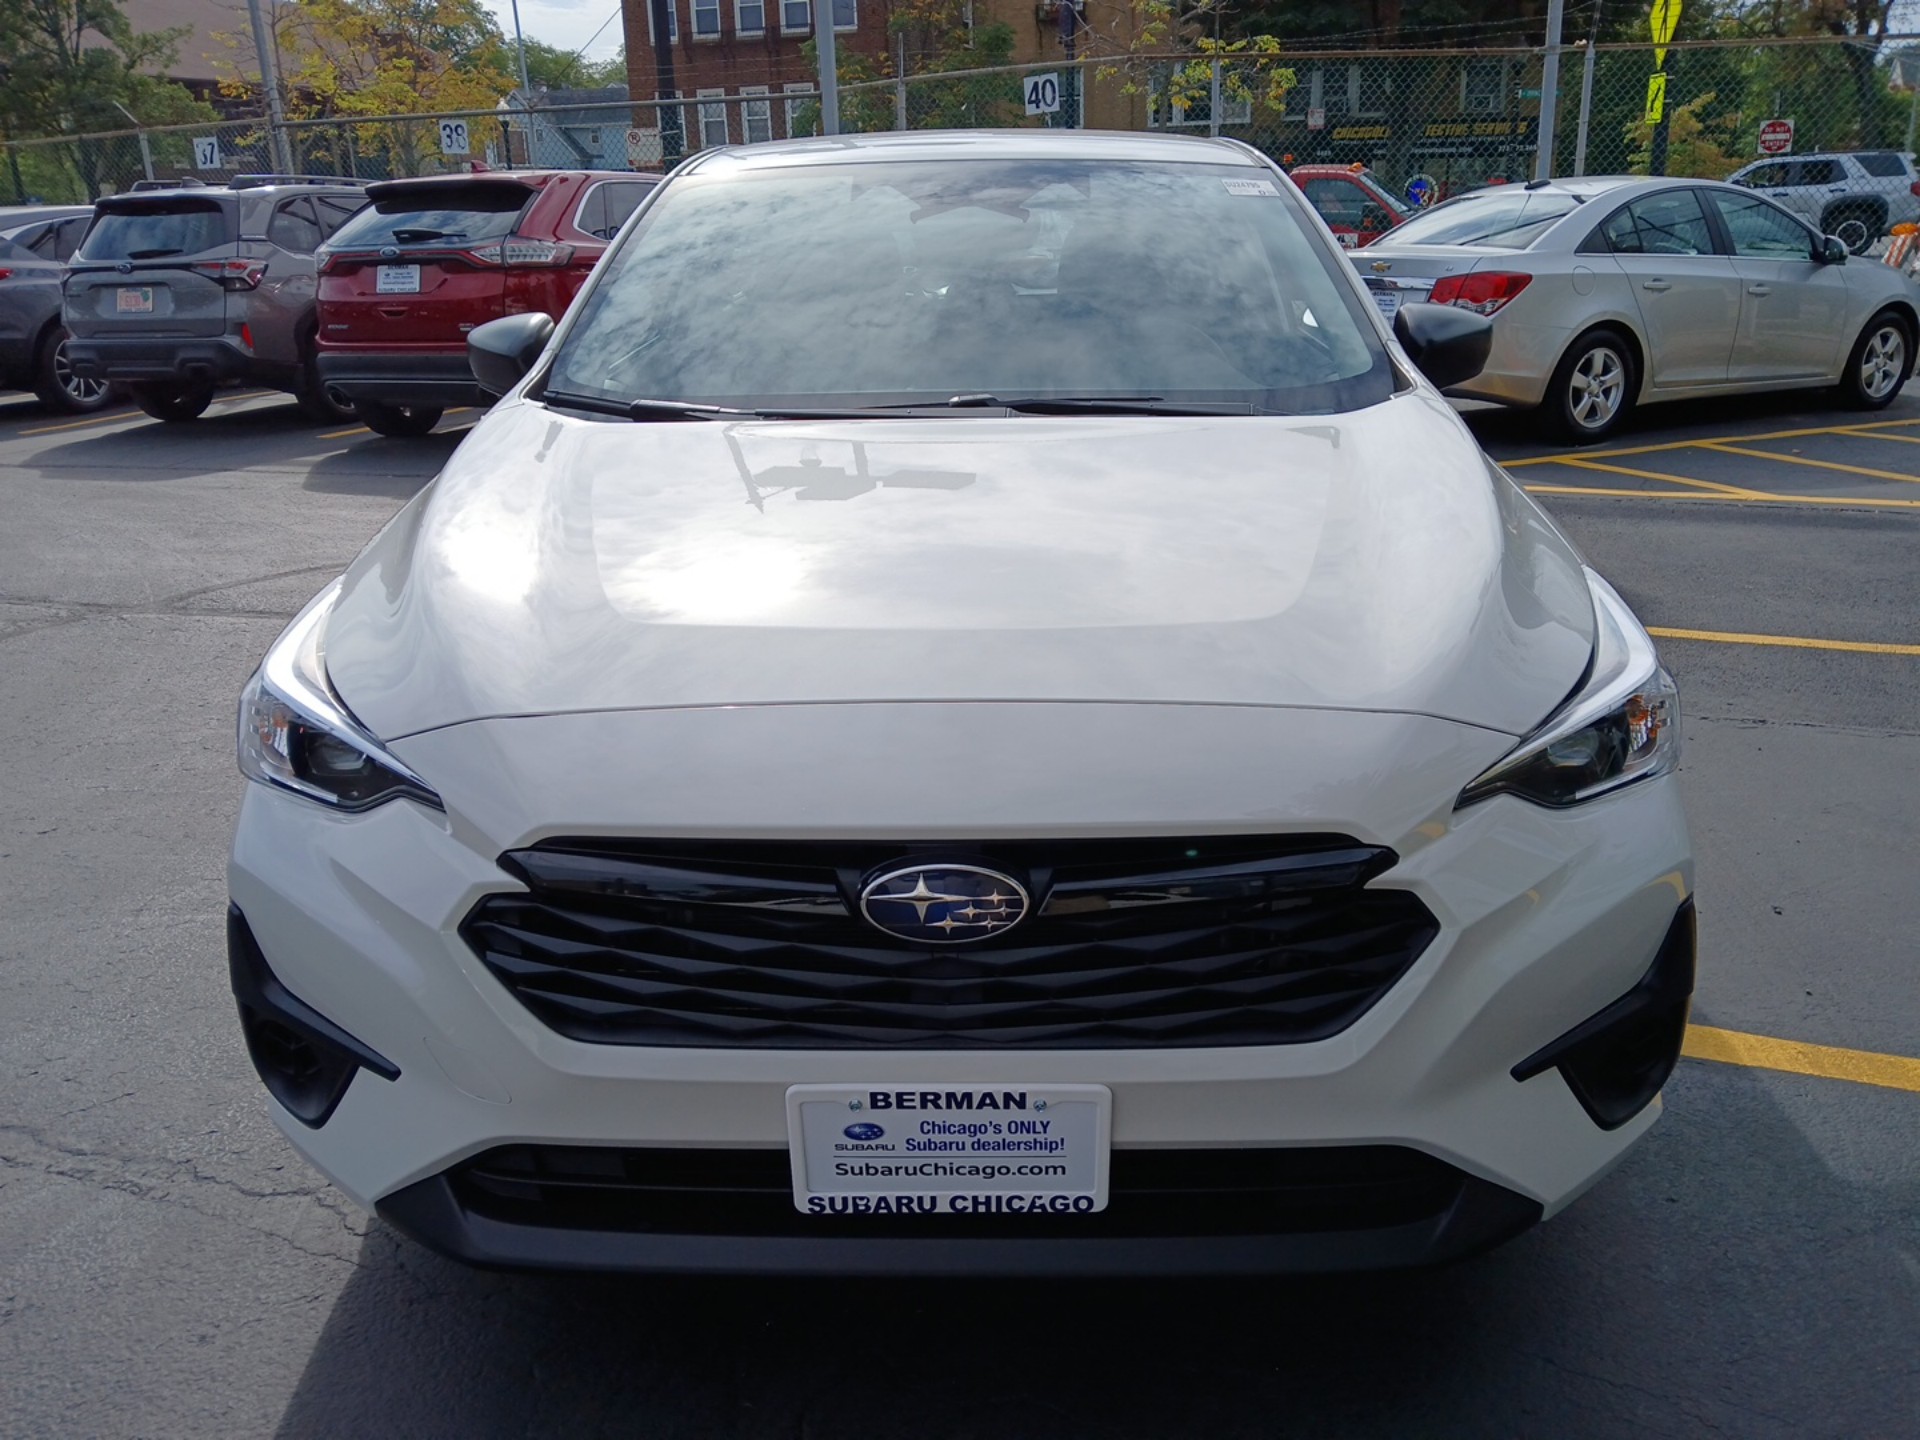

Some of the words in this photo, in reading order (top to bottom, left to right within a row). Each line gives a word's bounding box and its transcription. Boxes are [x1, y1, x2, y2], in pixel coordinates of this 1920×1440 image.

[1028, 79, 1056, 109] 40
[868, 1091, 1027, 1110] BERMAN
[919, 1120, 1003, 1137] Chicago's
[1007, 1120, 1051, 1135] ONLY
[834, 1143, 896, 1151] SUBARU
[905, 1137, 966, 1152] Subaru
[970, 1137, 1065, 1154] dealership!
[834, 1162, 1067, 1179] SubaruChicago.com
[807, 1195, 938, 1214] SUBARU
[948, 1195, 1095, 1214] CHICAGO
